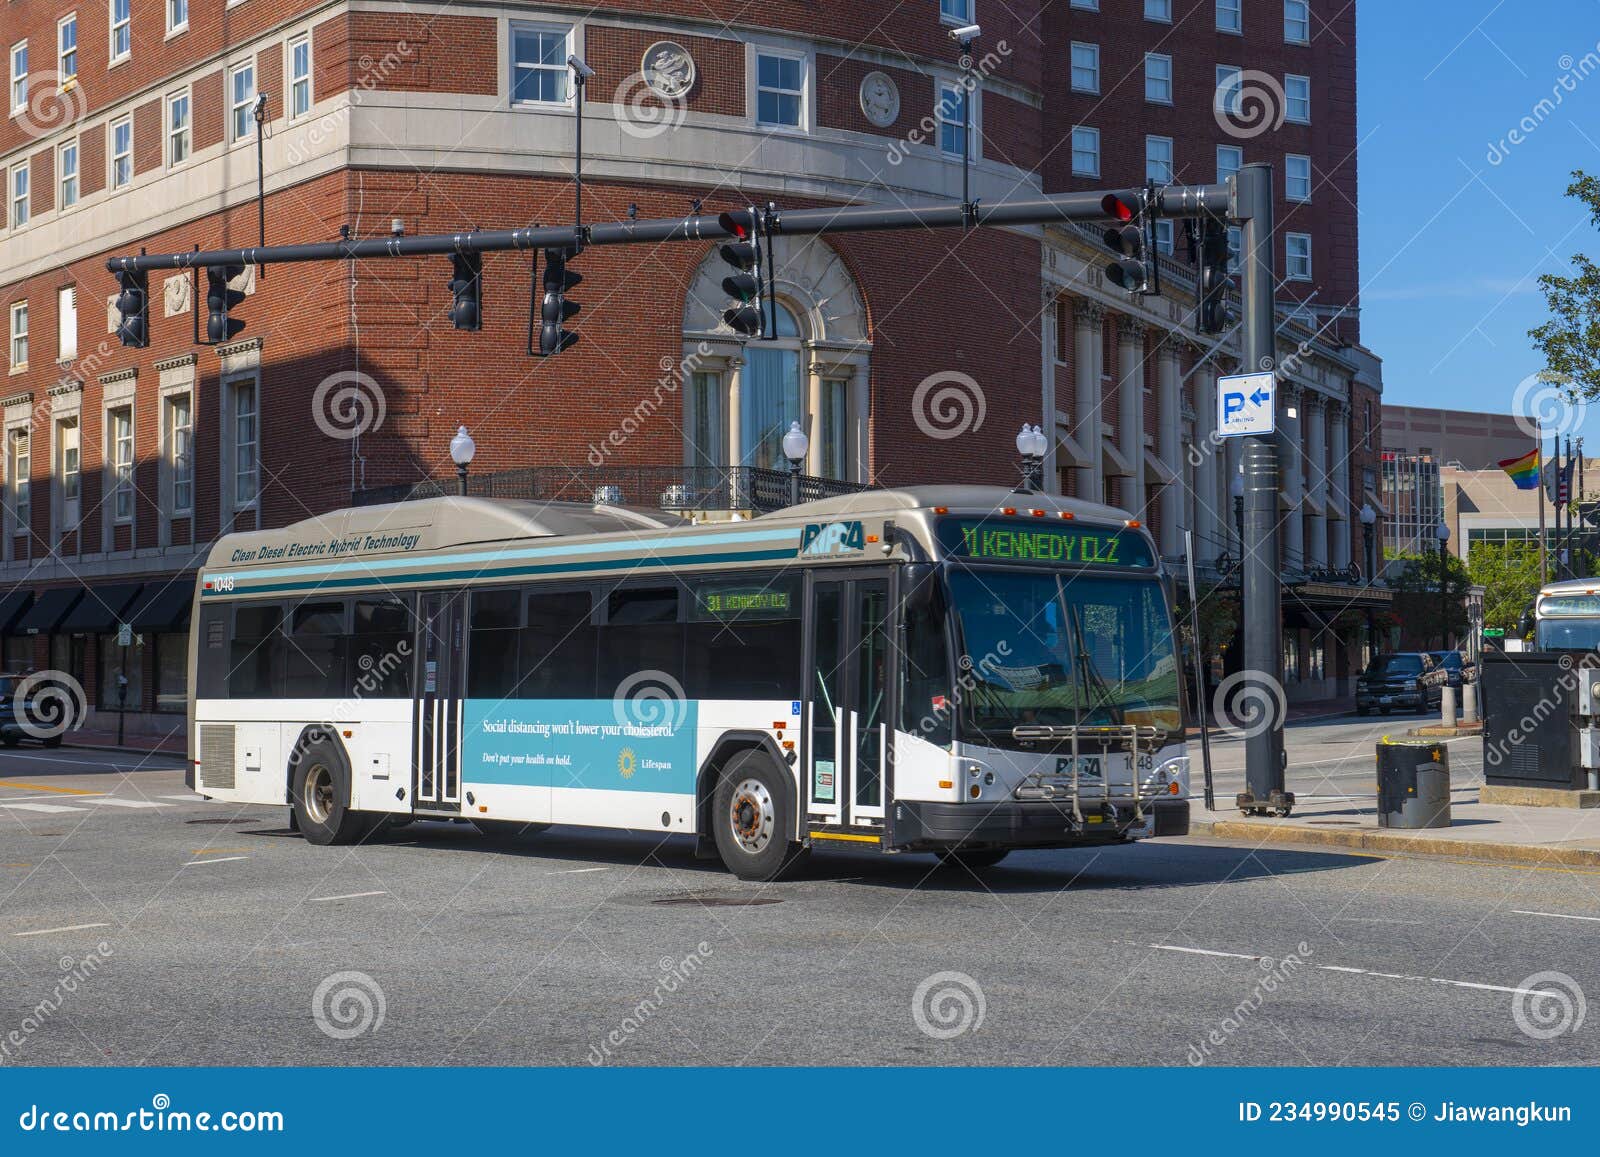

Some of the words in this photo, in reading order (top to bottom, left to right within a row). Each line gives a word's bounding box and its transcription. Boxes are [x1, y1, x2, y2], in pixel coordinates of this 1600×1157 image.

[231, 548, 256, 562] Clean
[257, 545, 286, 560] Diesel
[288, 541, 326, 557] Electric
[328, 537, 360, 556] Hybrid
[363, 534, 420, 551] Technology
[983, 530, 1075, 561] KENNEDY
[213, 576, 234, 592] 1048
[482, 719, 507, 733] Social
[508, 719, 550, 738] distancing
[552, 719, 574, 735] won't
[575, 720, 598, 735] lower
[601, 725, 621, 740] your
[623, 721, 675, 737] cholesterol.
[499, 754, 510, 767] put
[510, 756, 525, 767] your
[641, 759, 672, 772] Lifespan
